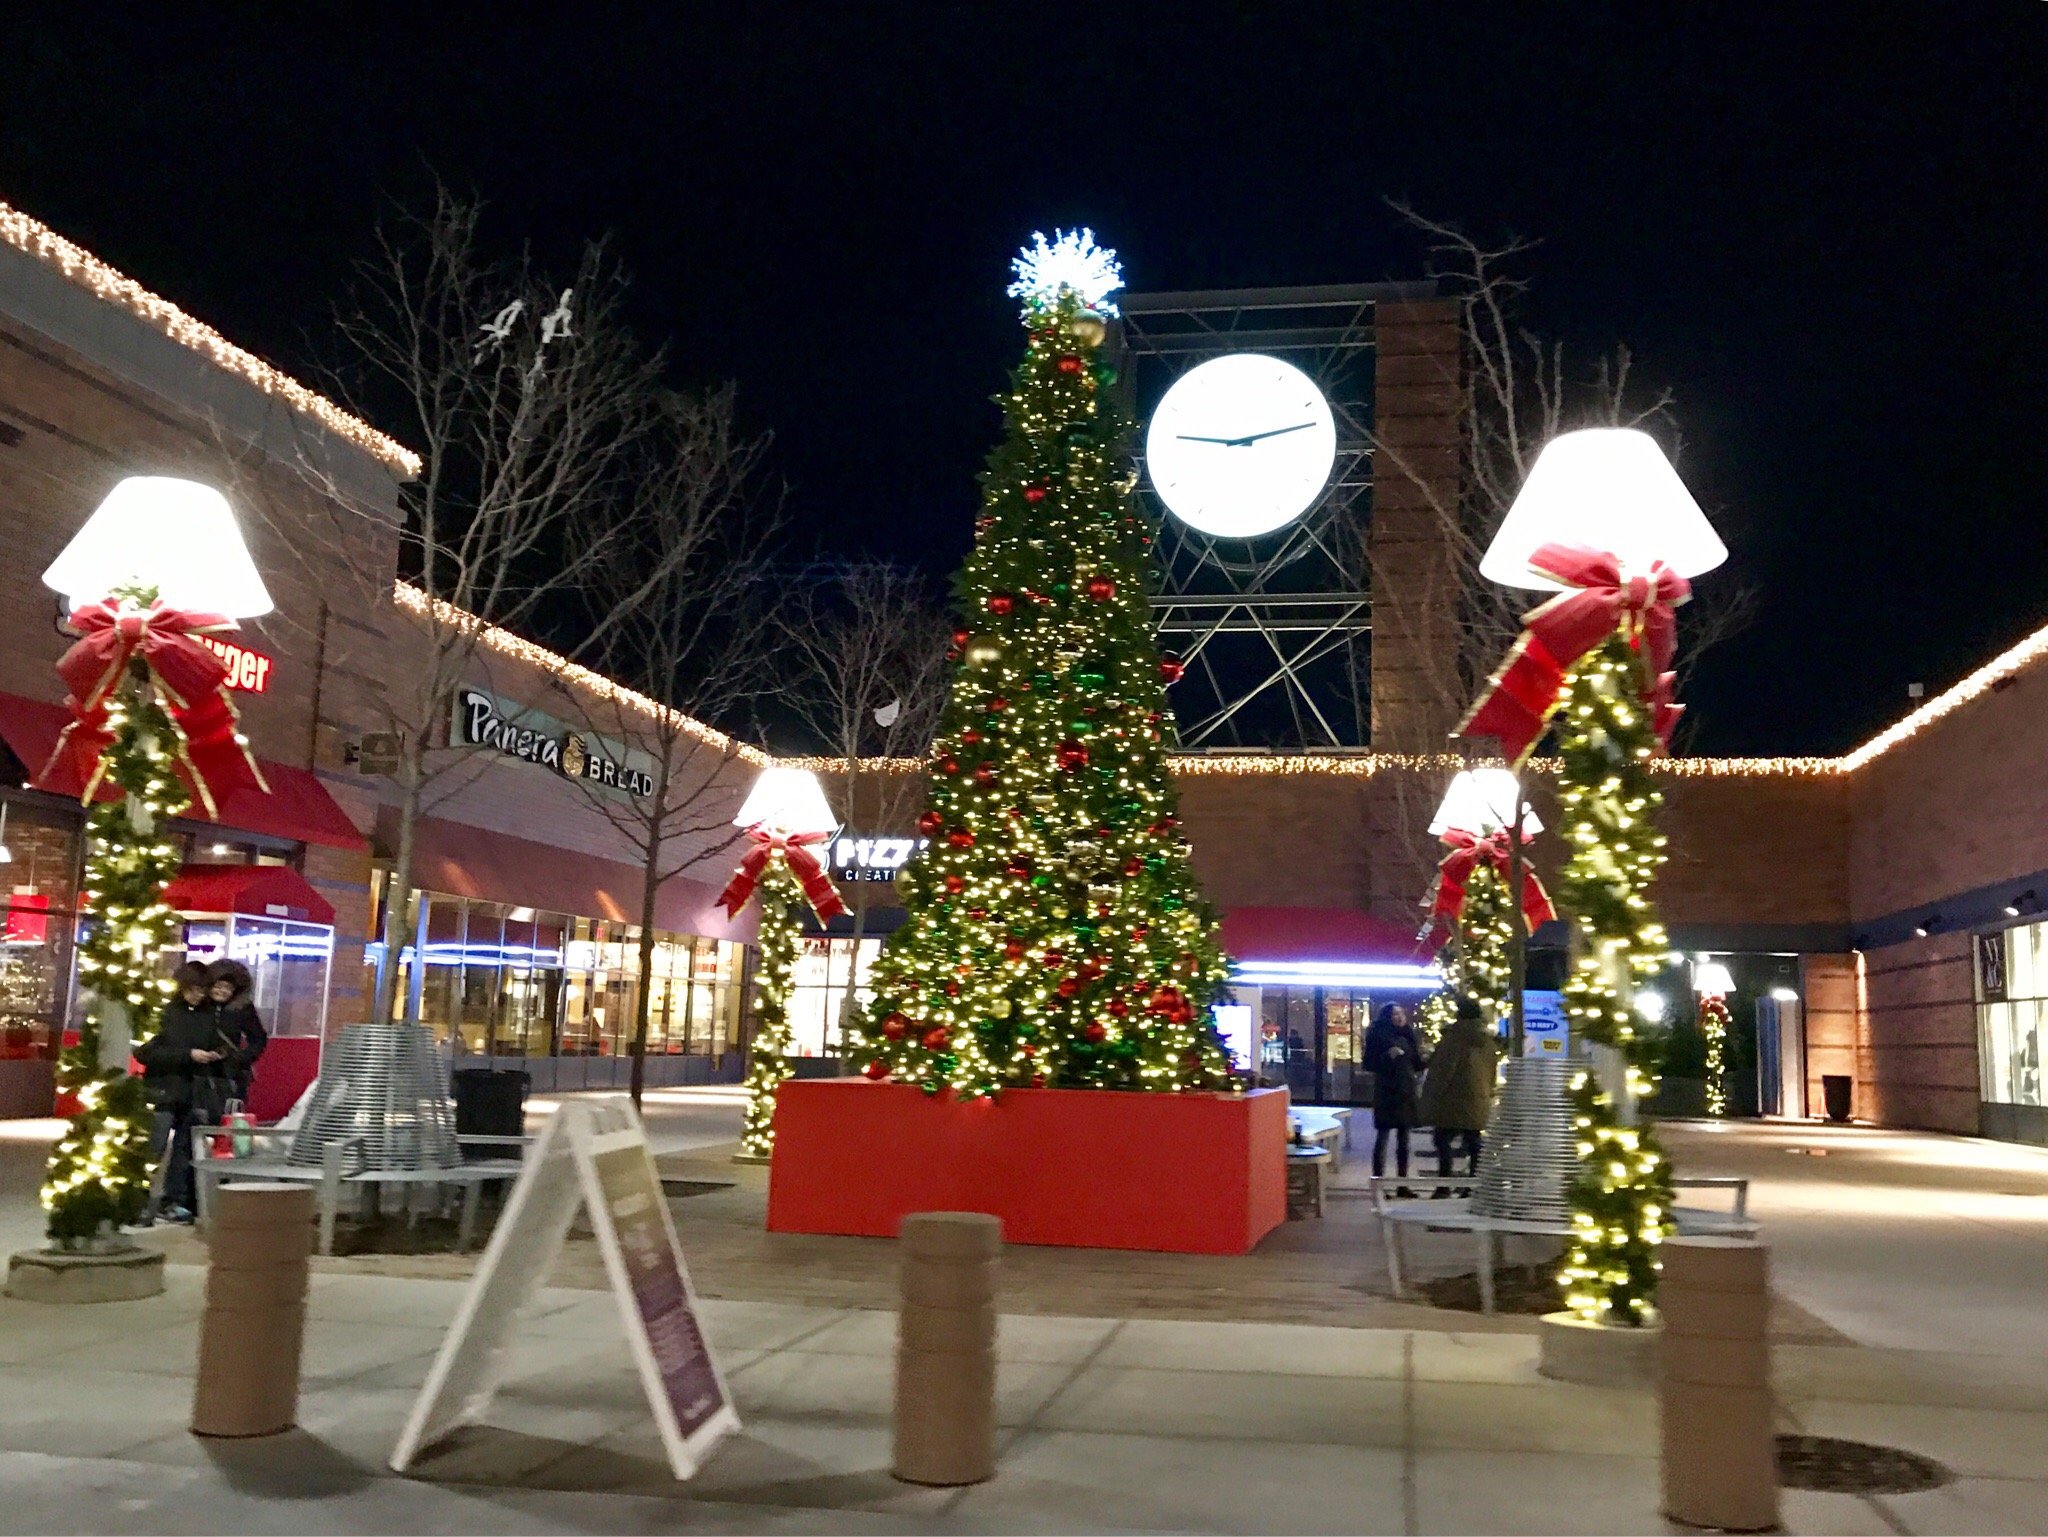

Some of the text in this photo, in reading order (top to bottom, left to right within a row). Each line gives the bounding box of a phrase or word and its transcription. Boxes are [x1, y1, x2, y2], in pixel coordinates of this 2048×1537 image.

[466, 692, 654, 797] Panera BREAD
[836, 838, 930, 867] PIZZ
